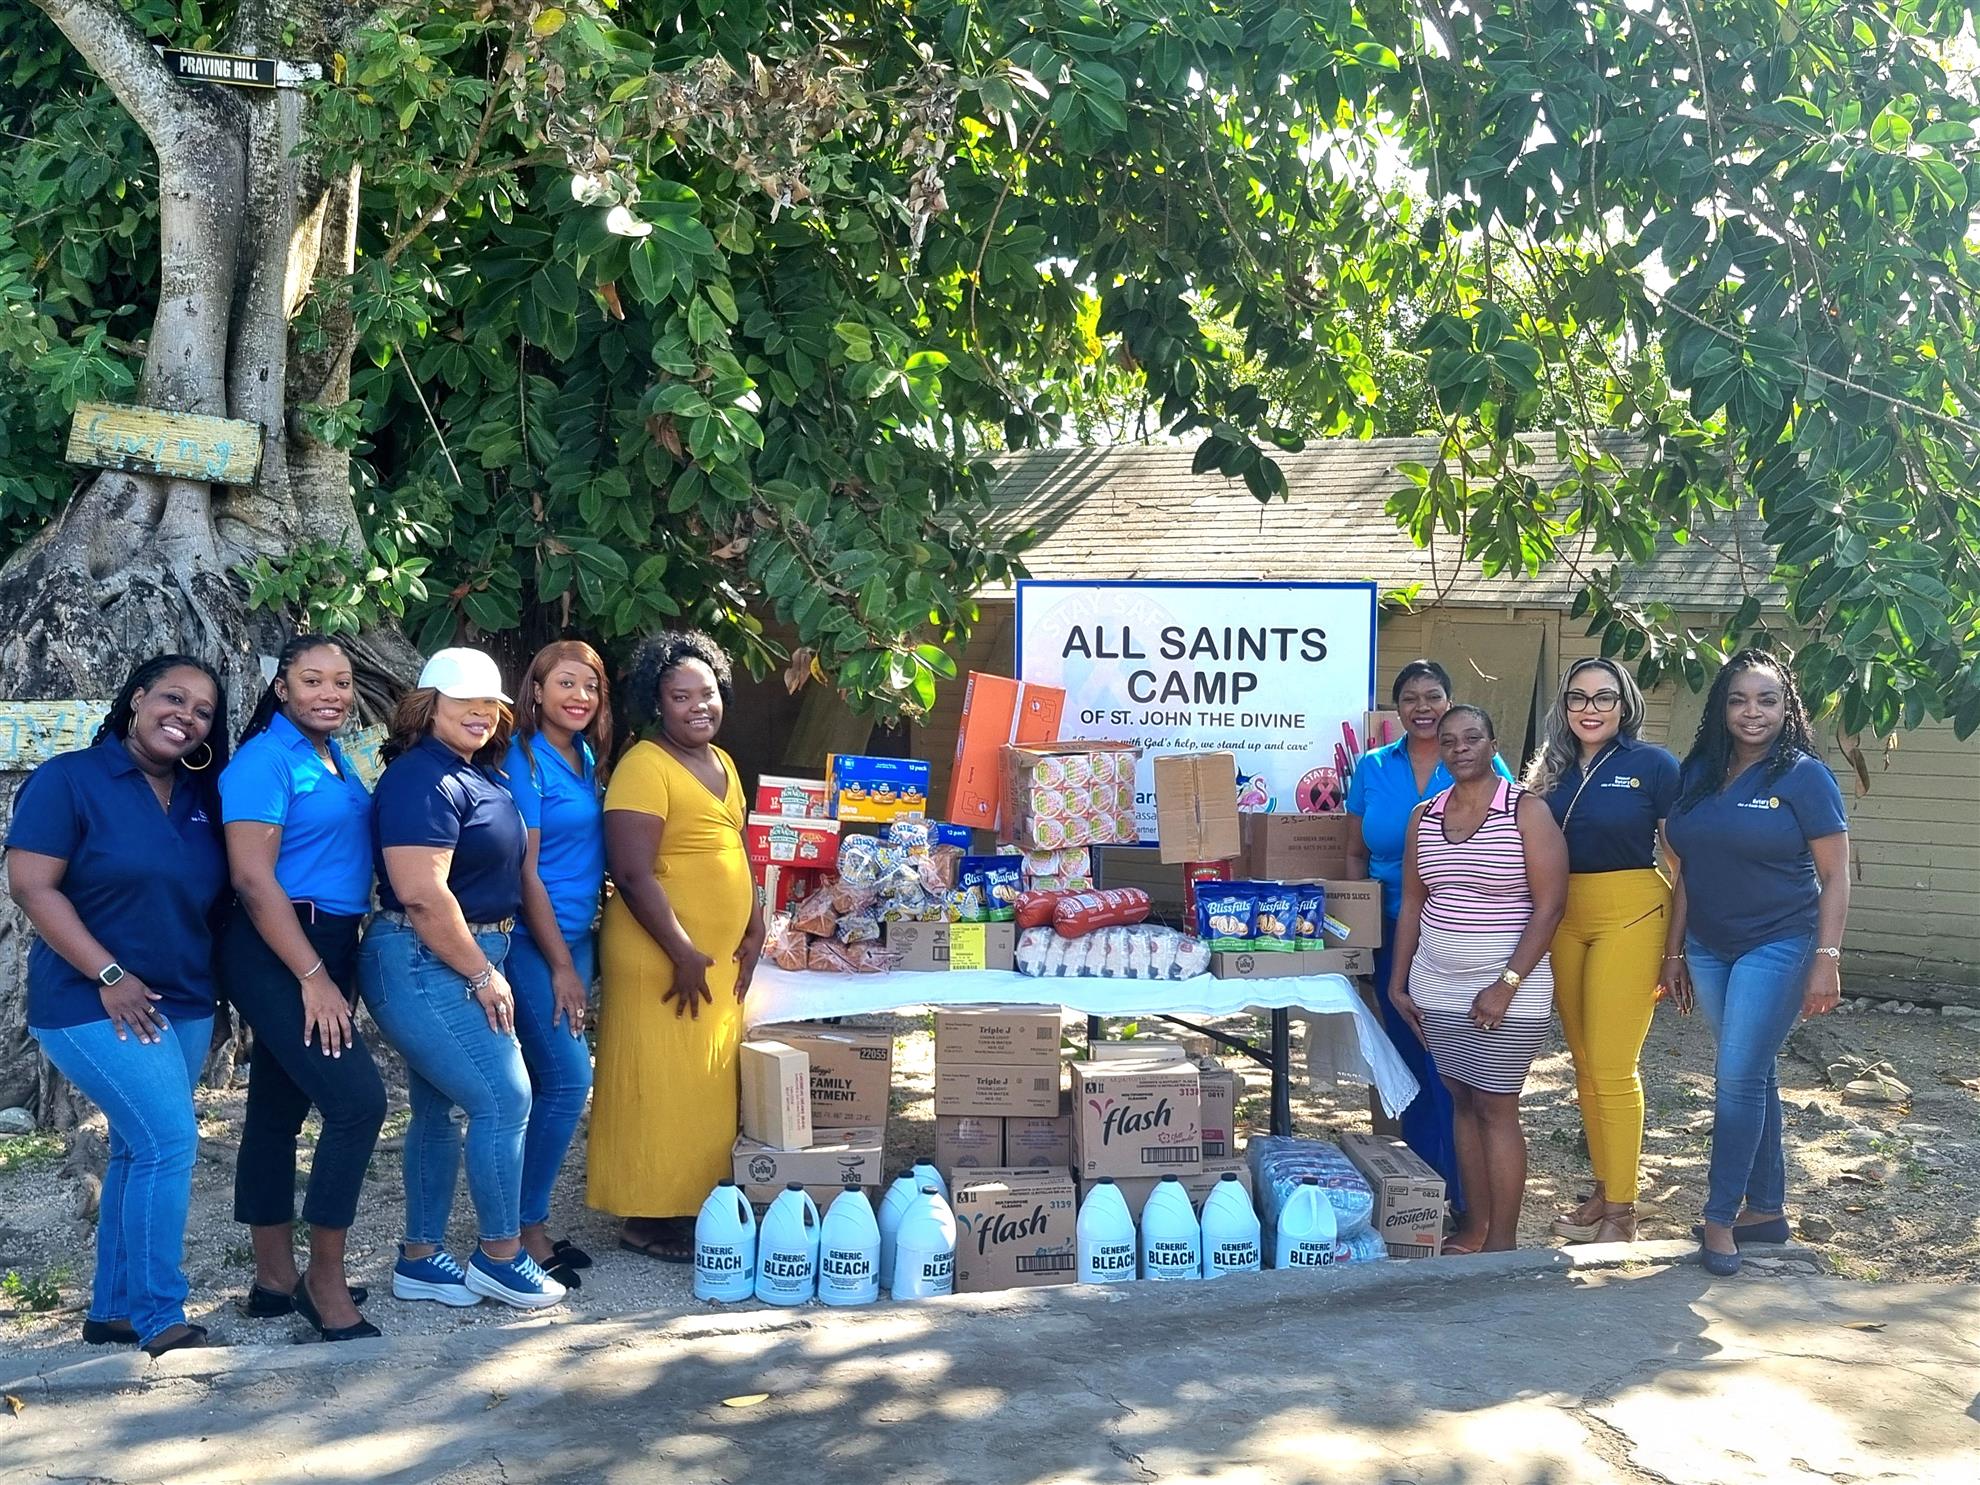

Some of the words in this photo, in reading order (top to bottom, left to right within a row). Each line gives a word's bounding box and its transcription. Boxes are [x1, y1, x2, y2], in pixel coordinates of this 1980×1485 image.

[179, 55, 231, 78] PRAYING
[234, 61, 259, 81] HILL
[1062, 625, 1146, 659] ALL
[1160, 626, 1327, 662] SAINTS
[1127, 670, 1258, 705] CAMP
[1080, 710, 1105, 724] OF
[1110, 710, 1133, 725] ST.
[1139, 711, 1192, 726] JOHN
[1197, 712, 1235, 727] THE
[1241, 713, 1305, 729] DIVINE
[1217, 740, 1244, 749] stand
[1248, 743, 1261, 752] up
[1264, 741, 1284, 750] and
[1303, 769, 1325, 785] STAY
[1135, 792, 1157, 808] ary
[1135, 811, 1157, 821] assa
[1136, 826, 1157, 834] artner
[1258, 900, 1290, 913] lissfuls
[979, 1027, 1003, 1035] Triple
[861, 1048, 886, 1060] 22055
[810, 1077, 853, 1089] FAMILY
[976, 1078, 1001, 1086] Triple
[810, 1090, 857, 1102] RTMENT
[1103, 1098, 1172, 1146] flash
[1050, 1200, 1072, 1209] 3139
[977, 1204, 1048, 1256] flash
[701, 1245, 734, 1256] GENERIC
[1100, 1244, 1131, 1255] GENERIC
[1155, 1242, 1188, 1251] GENERIC
[1221, 1241, 1253, 1252] GENERIC
[1299, 1242, 1330, 1252] GENERIC
[772, 1252, 806, 1263] GENERIC
[829, 1250, 862, 1260] GENERIC
[1092, 1251, 1135, 1269] BLEACH
[1148, 1250, 1195, 1266] BLEACH
[1213, 1249, 1259, 1266] BLEACH
[1290, 1250, 1334, 1266] BLEACH
[696, 1253, 742, 1270] BLEACH
[823, 1258, 870, 1275] BLEACH
[764, 1260, 812, 1277] BLEACH
